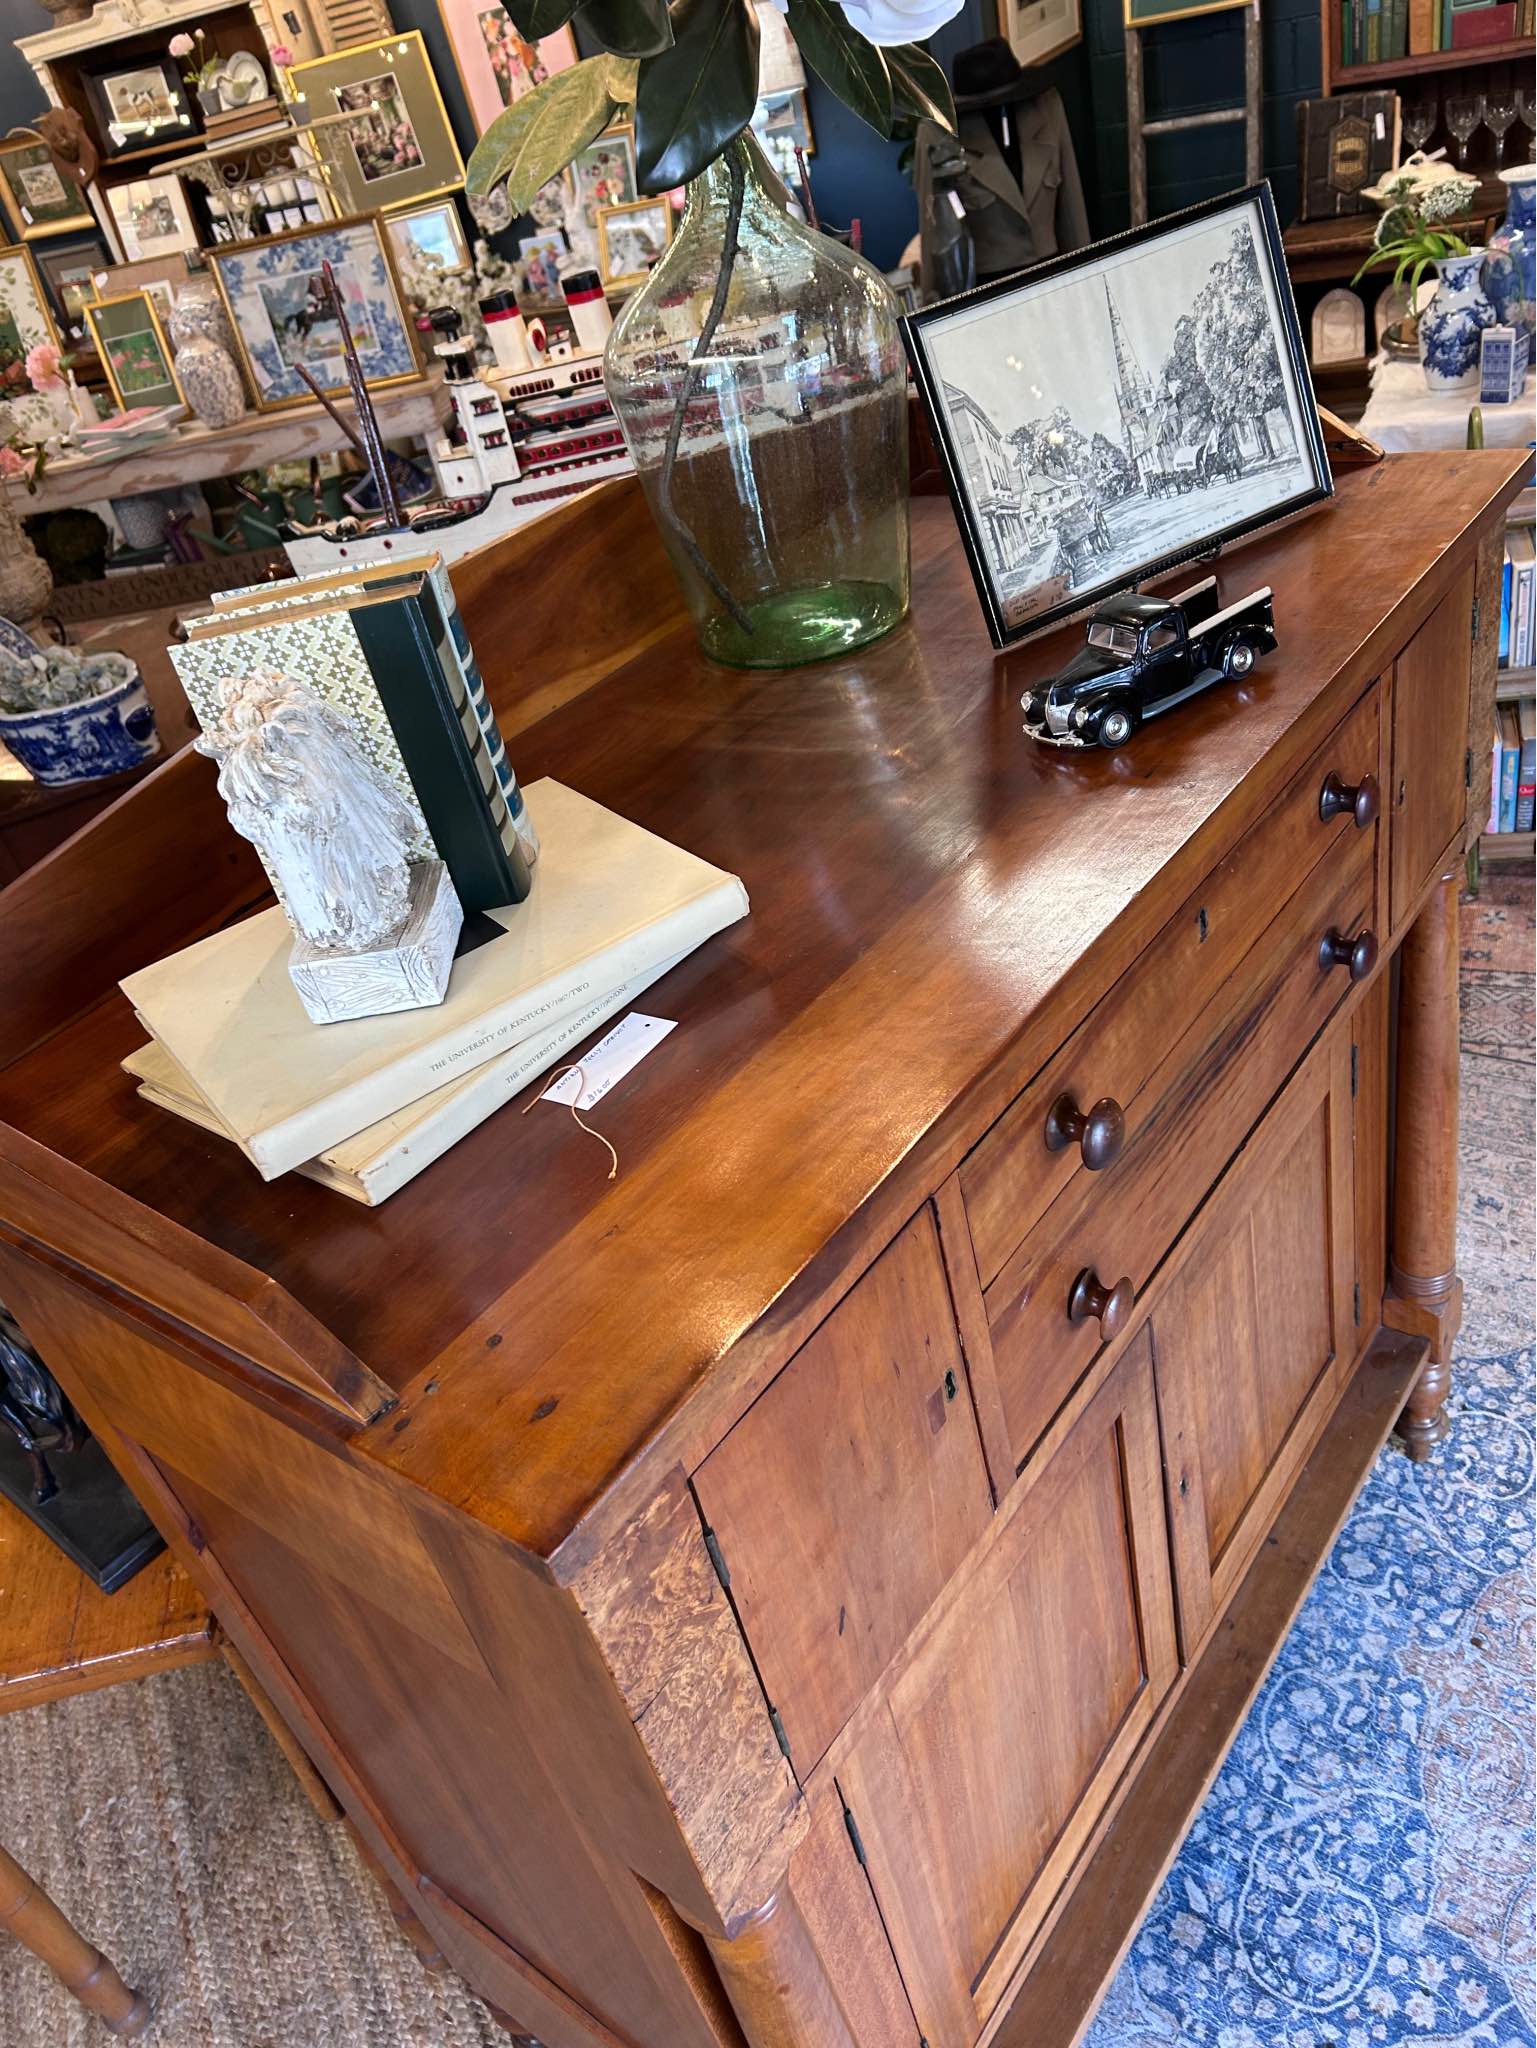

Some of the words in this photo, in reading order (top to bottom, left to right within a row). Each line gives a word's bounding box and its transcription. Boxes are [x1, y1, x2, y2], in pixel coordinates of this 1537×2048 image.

[429, 1059, 448, 1072] THE
[448, 1033, 495, 1063] UNIVERSITY
[497, 1026, 509, 1037] OF
[505, 1070, 520, 1084] THE
[520, 1041, 557, 1073] UNIVERSITY
